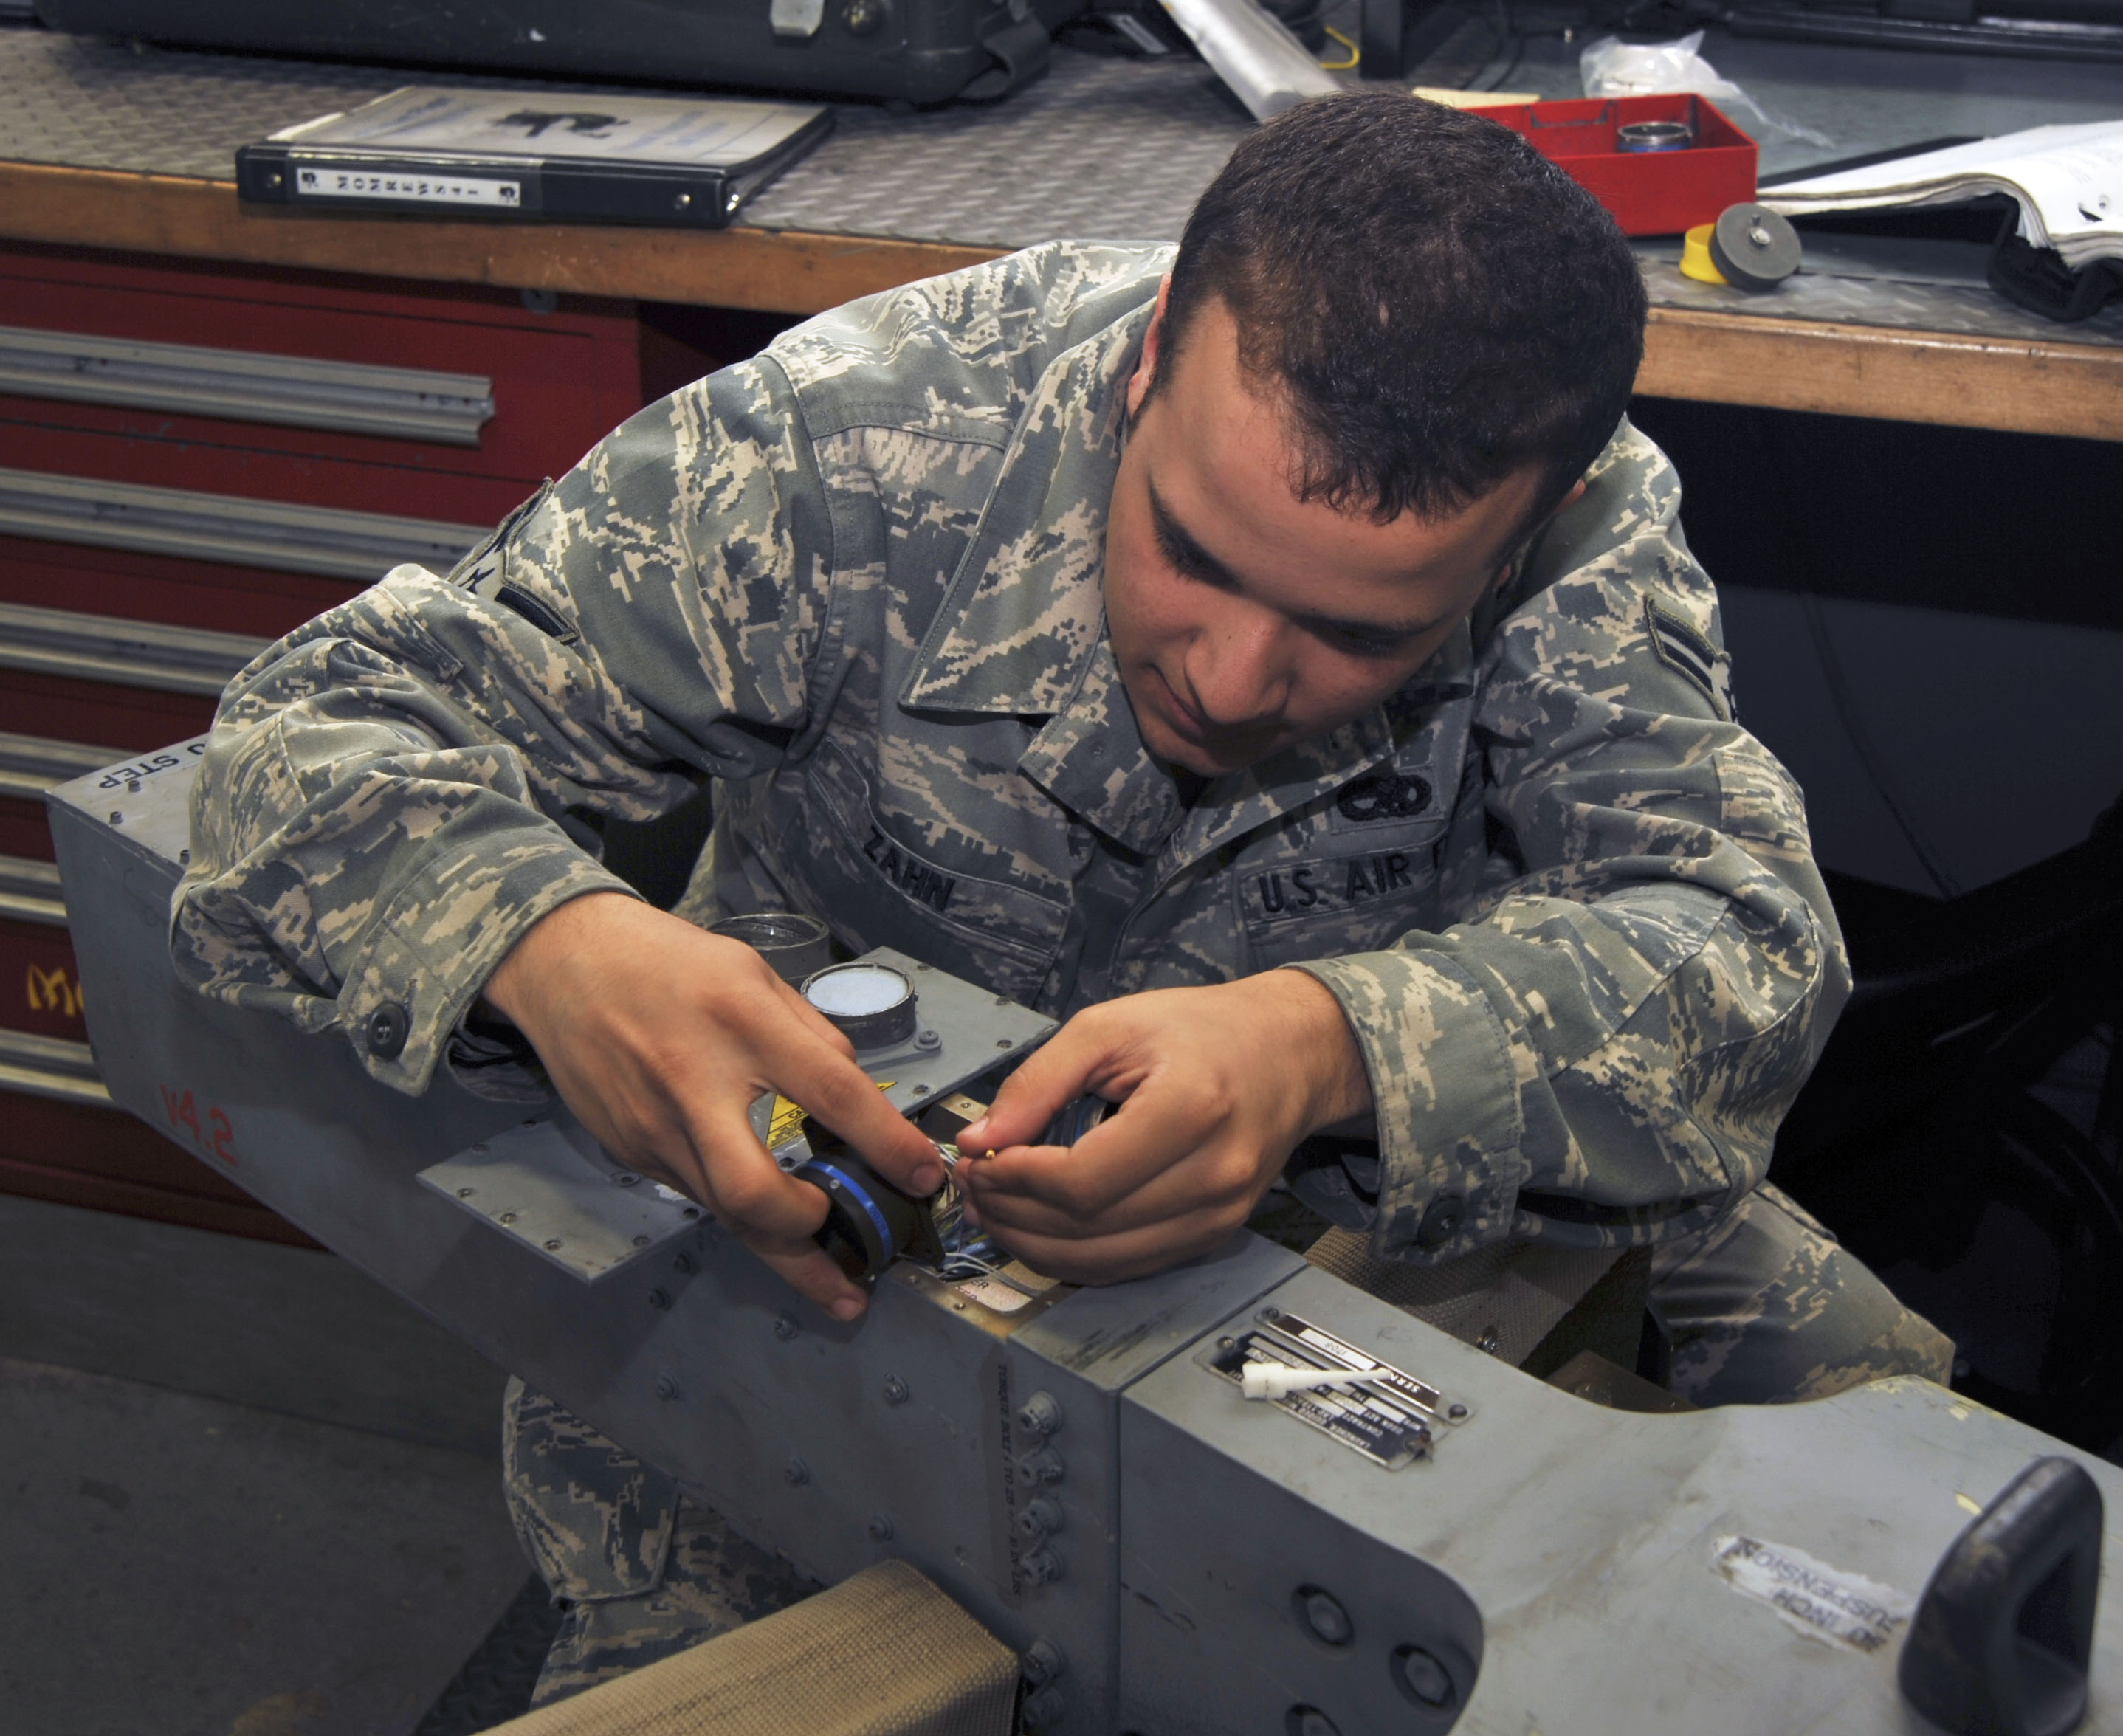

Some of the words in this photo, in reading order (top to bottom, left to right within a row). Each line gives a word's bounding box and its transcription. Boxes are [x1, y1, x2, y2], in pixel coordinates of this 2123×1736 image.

[99, 755, 179, 788] STEP
[864, 825, 956, 913] ZAHN
[1259, 868, 1329, 913] U.S.
[1346, 854, 1411, 900] AIR
[159, 1084, 239, 1167] V4.2
[1324, 1342, 1348, 1356] 1708
[998, 1364, 1010, 1418] TORQUE
[1772, 1588, 1841, 1628] INCH
